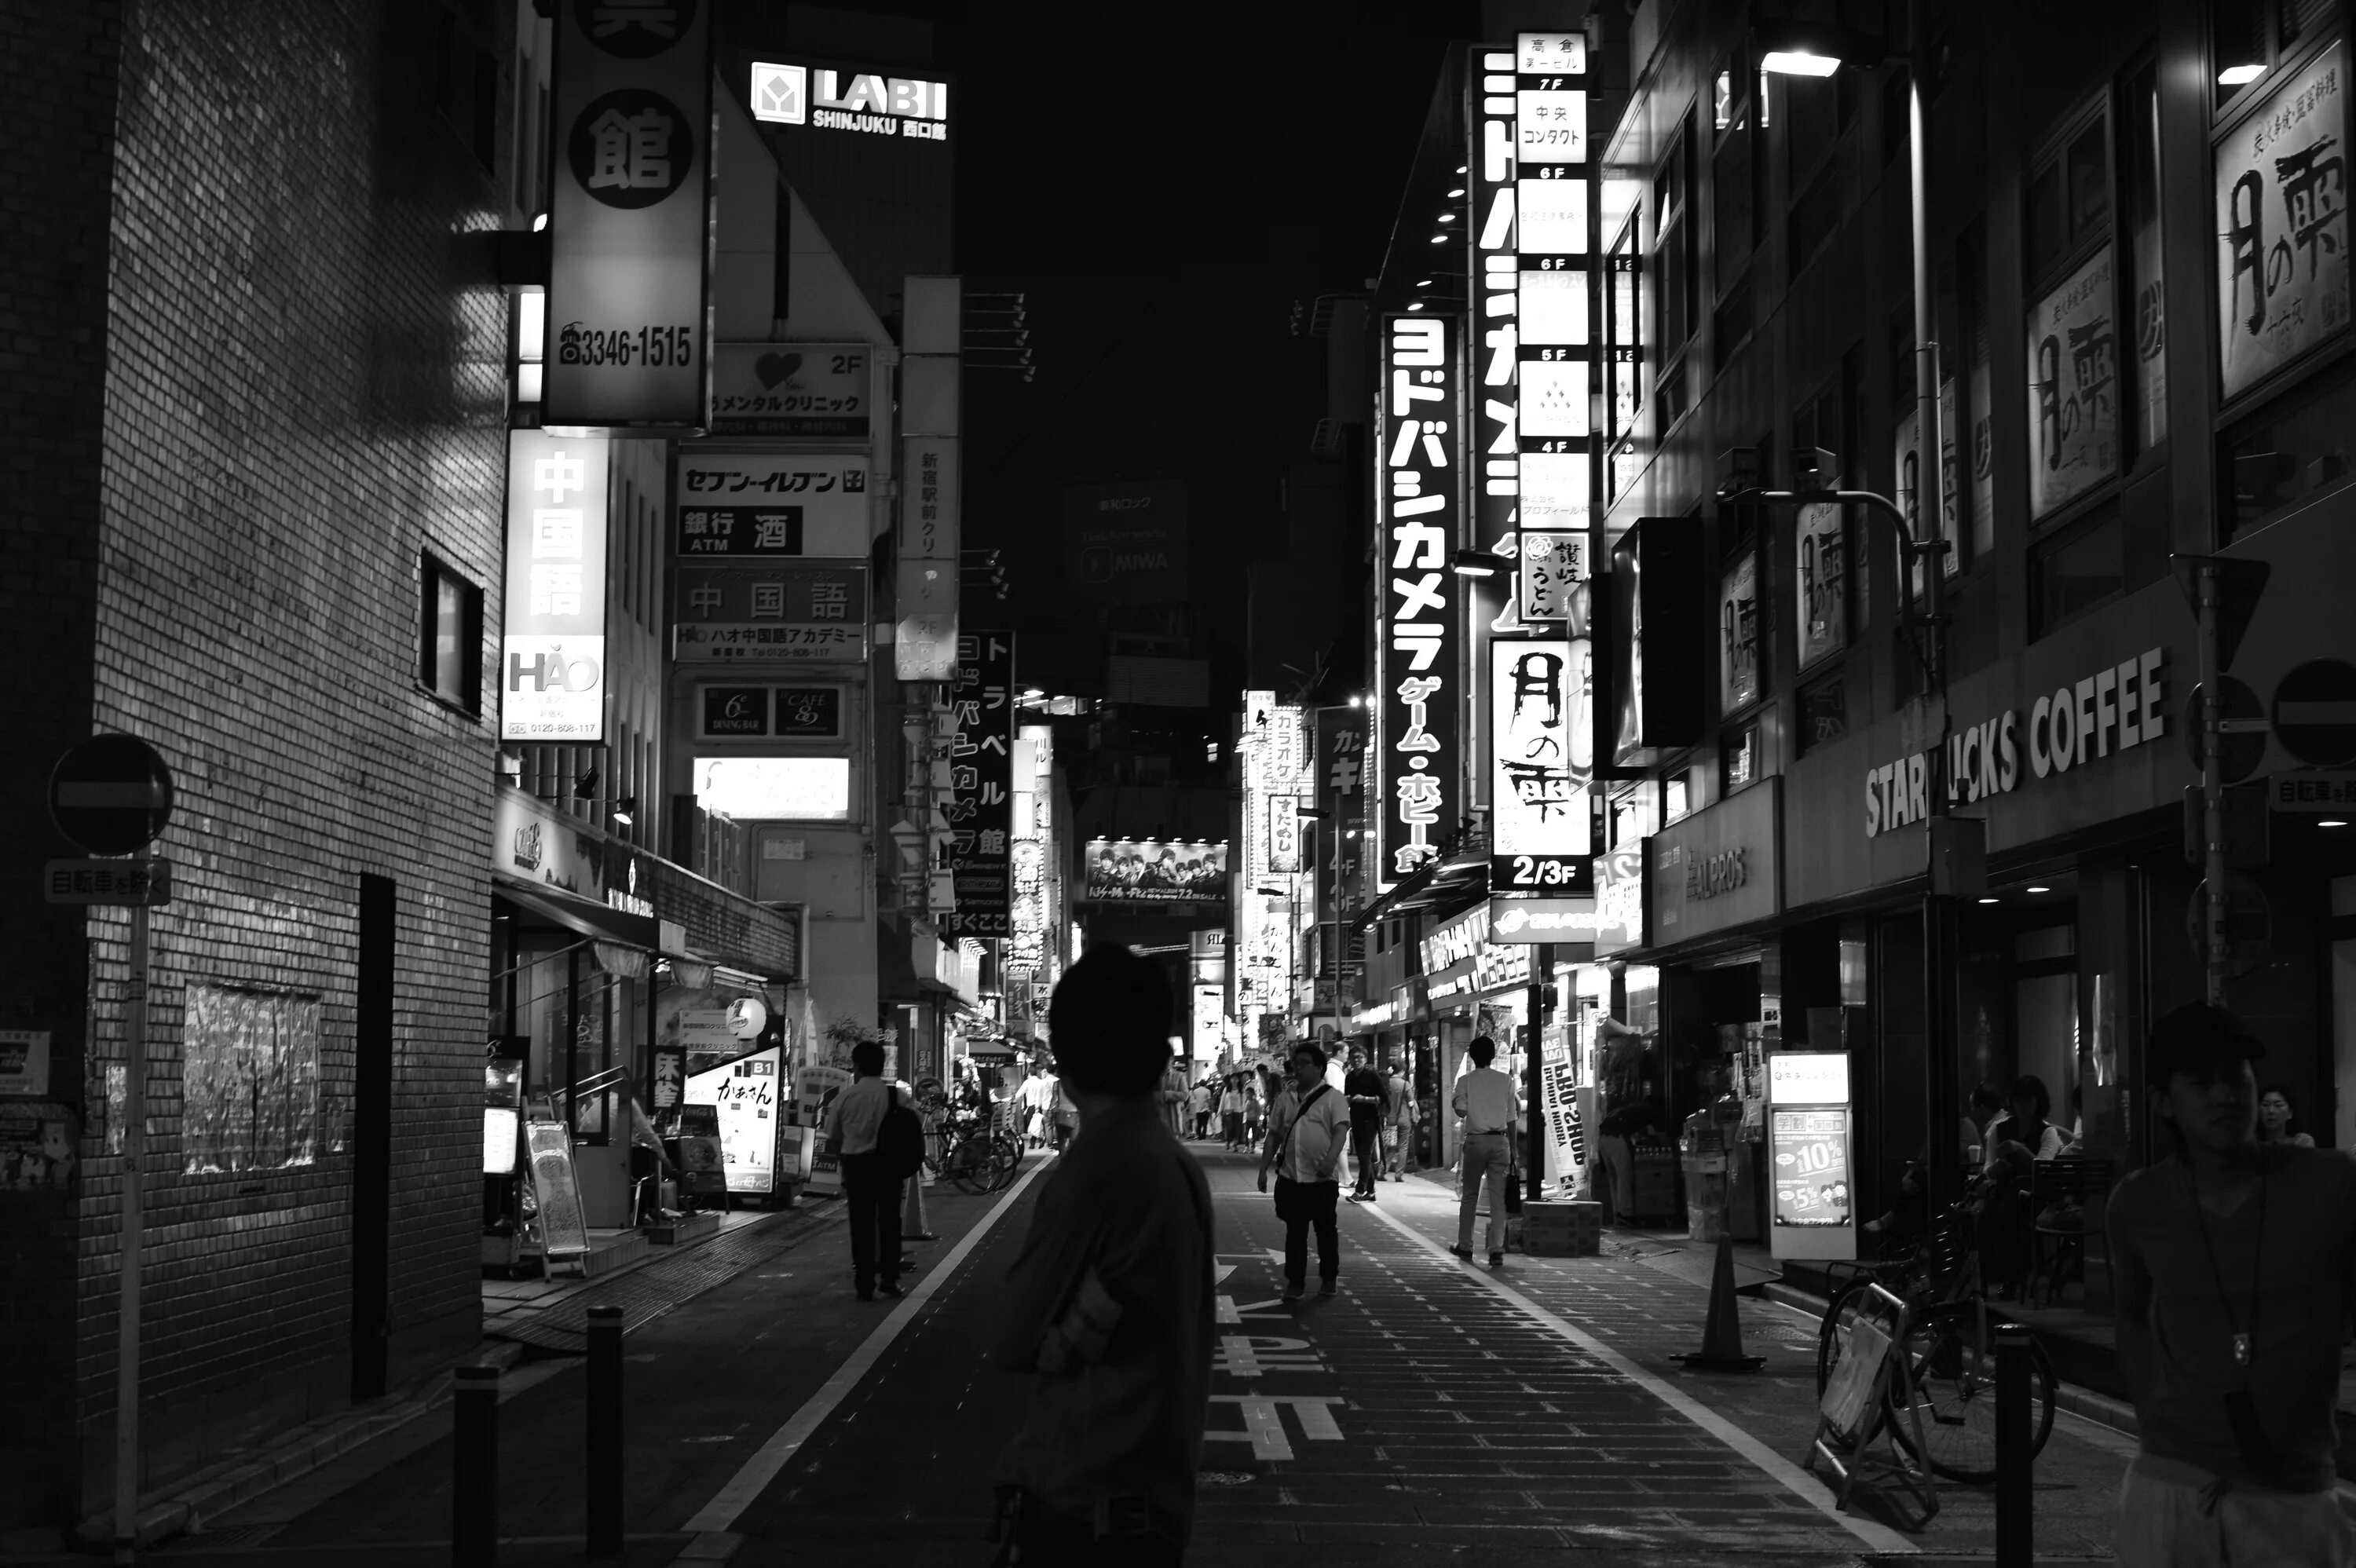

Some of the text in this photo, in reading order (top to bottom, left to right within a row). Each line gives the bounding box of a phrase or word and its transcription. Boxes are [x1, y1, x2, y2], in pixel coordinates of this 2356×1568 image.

[1531, 38, 1575, 53] 高倉
[813, 68, 947, 121] LABI
[1539, 79, 1563, 90] 7F
[813, 109, 947, 141] SHINJUKU 西口館
[1535, 105, 1568, 121] 中央
[1524, 129, 1579, 146] コンタクト
[1539, 167, 1565, 179] 6F
[1540, 258, 1566, 270] 6F
[582, 326, 691, 367] 3346-1515
[1541, 349, 1567, 361] 5F
[831, 356, 862, 374] 2F
[1541, 441, 1568, 453] 4F
[1388, 319, 1448, 671] ヨドバシカメラ
[684, 511, 788, 549] 銀行 酒
[690, 539, 729, 551] ATM
[1115, 551, 1169, 572] MIWA
[690, 580, 849, 620] 中国語
[1530, 566, 1554, 616] うどん
[2030, 646, 2165, 780] COFFEE
[951, 635, 981, 854] ヨドバシカメラ
[979, 637, 1008, 855] トラベル館
[1277, 715, 1292, 778] カラオケ
[1866, 710, 2020, 839] STARUCKS
[1513, 855, 1576, 886] 2/3F
[52, 871, 163, 895] 自転車を除く
[950, 912, 1008, 931] すぐここ
[753, 1062, 772, 1075] B1
